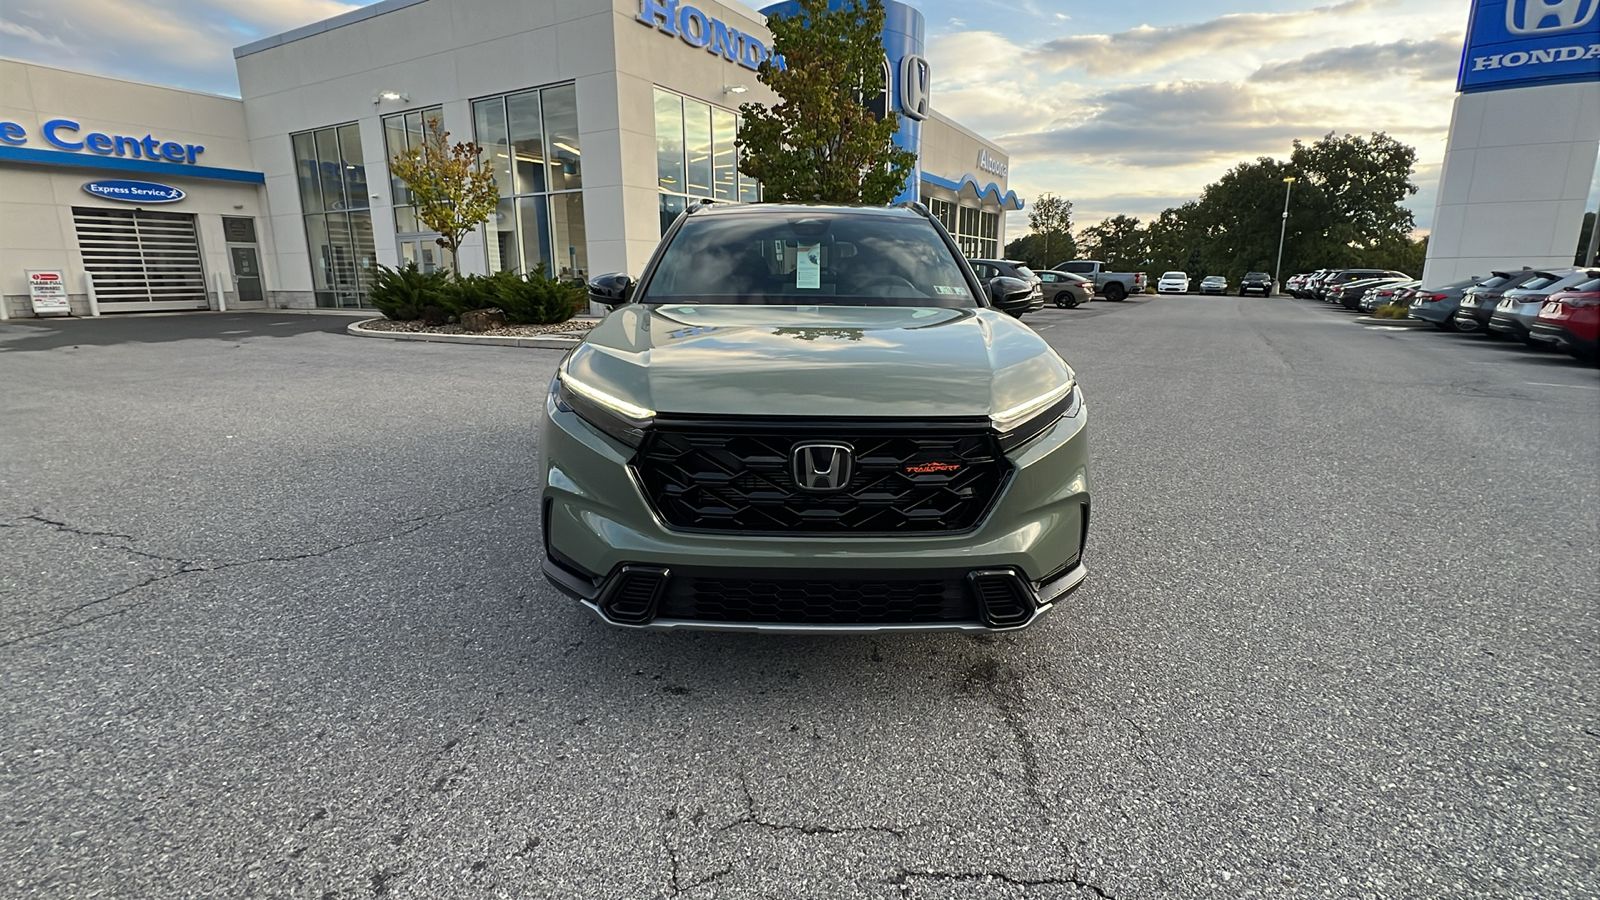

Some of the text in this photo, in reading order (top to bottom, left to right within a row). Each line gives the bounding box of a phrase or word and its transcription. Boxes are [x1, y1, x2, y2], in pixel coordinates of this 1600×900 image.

[1472, 44, 1600, 71] HONDA
[41, 119, 204, 164] Center
[90, 183, 166, 197] Express Service
[906, 464, 960, 473] TRAILSPORT
